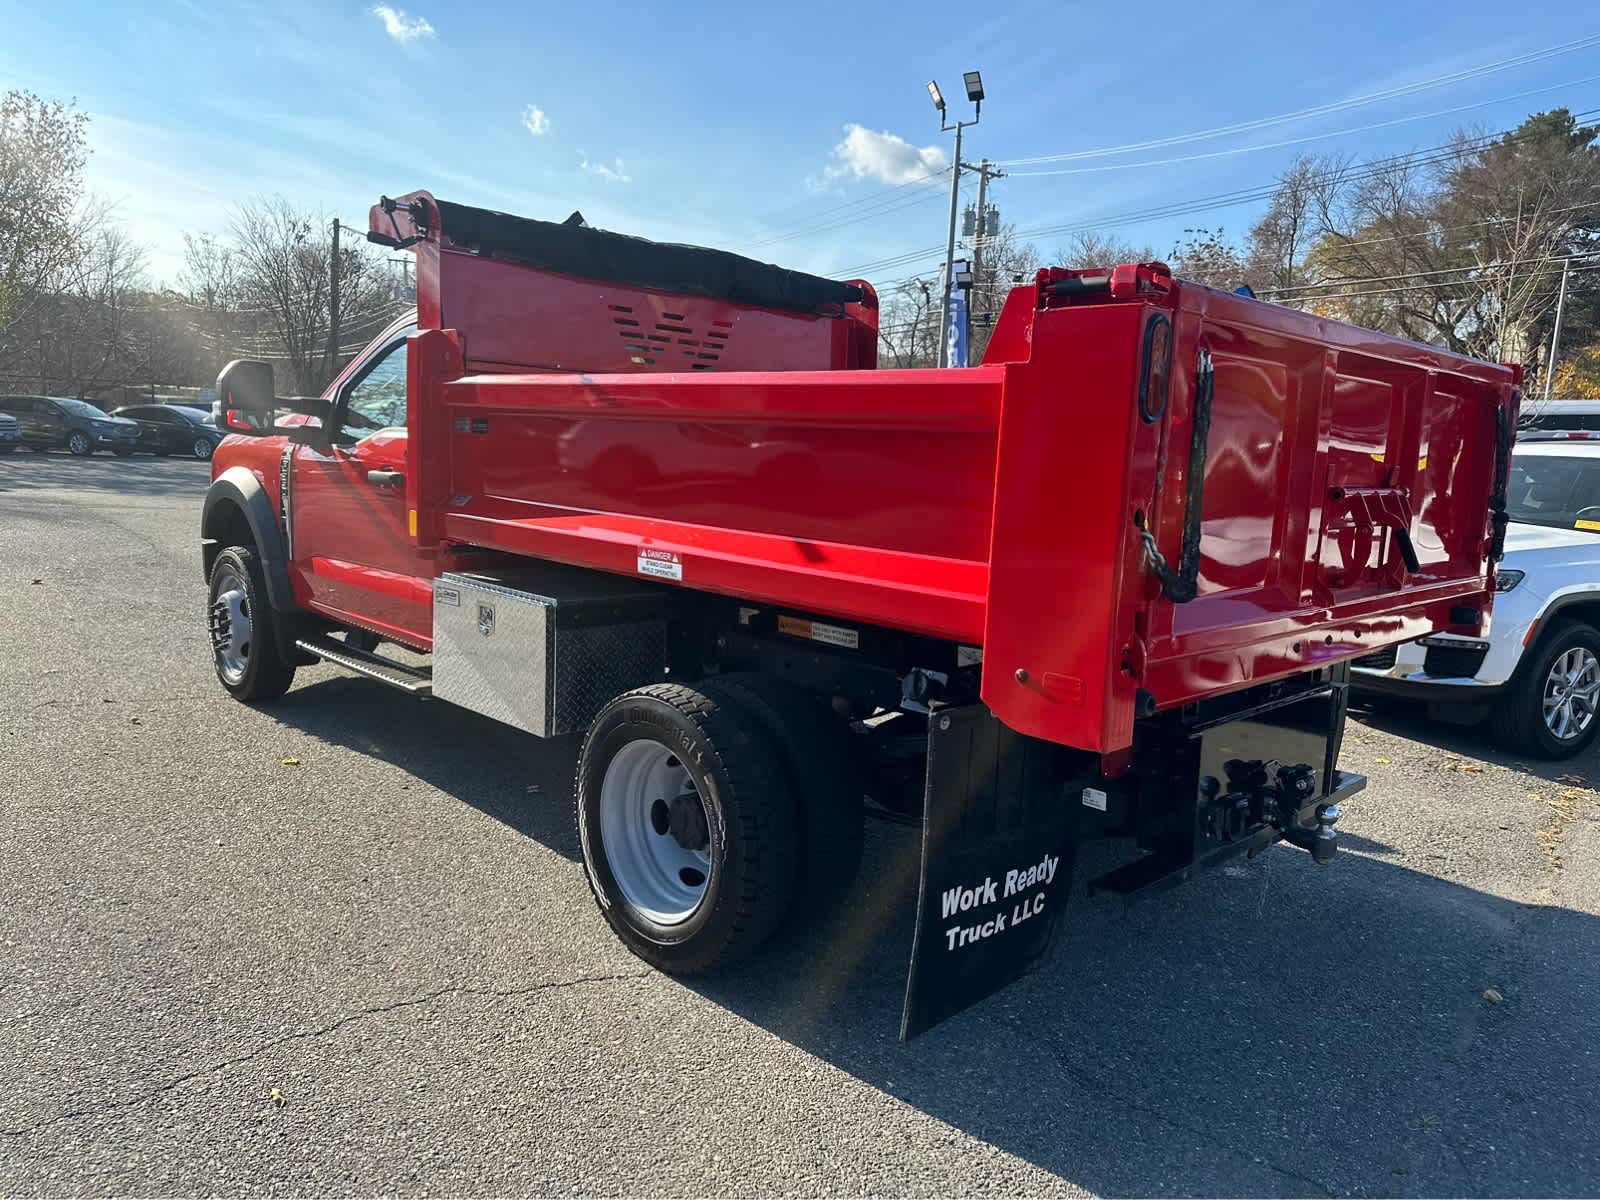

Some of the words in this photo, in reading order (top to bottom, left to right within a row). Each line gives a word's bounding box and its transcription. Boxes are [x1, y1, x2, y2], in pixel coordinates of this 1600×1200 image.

[647, 549, 672, 561] DANGER
[942, 877, 998, 919] Work
[1003, 854, 1059, 898] Ready
[946, 912, 1007, 951] Truck
[1011, 892, 1046, 926] LLC
